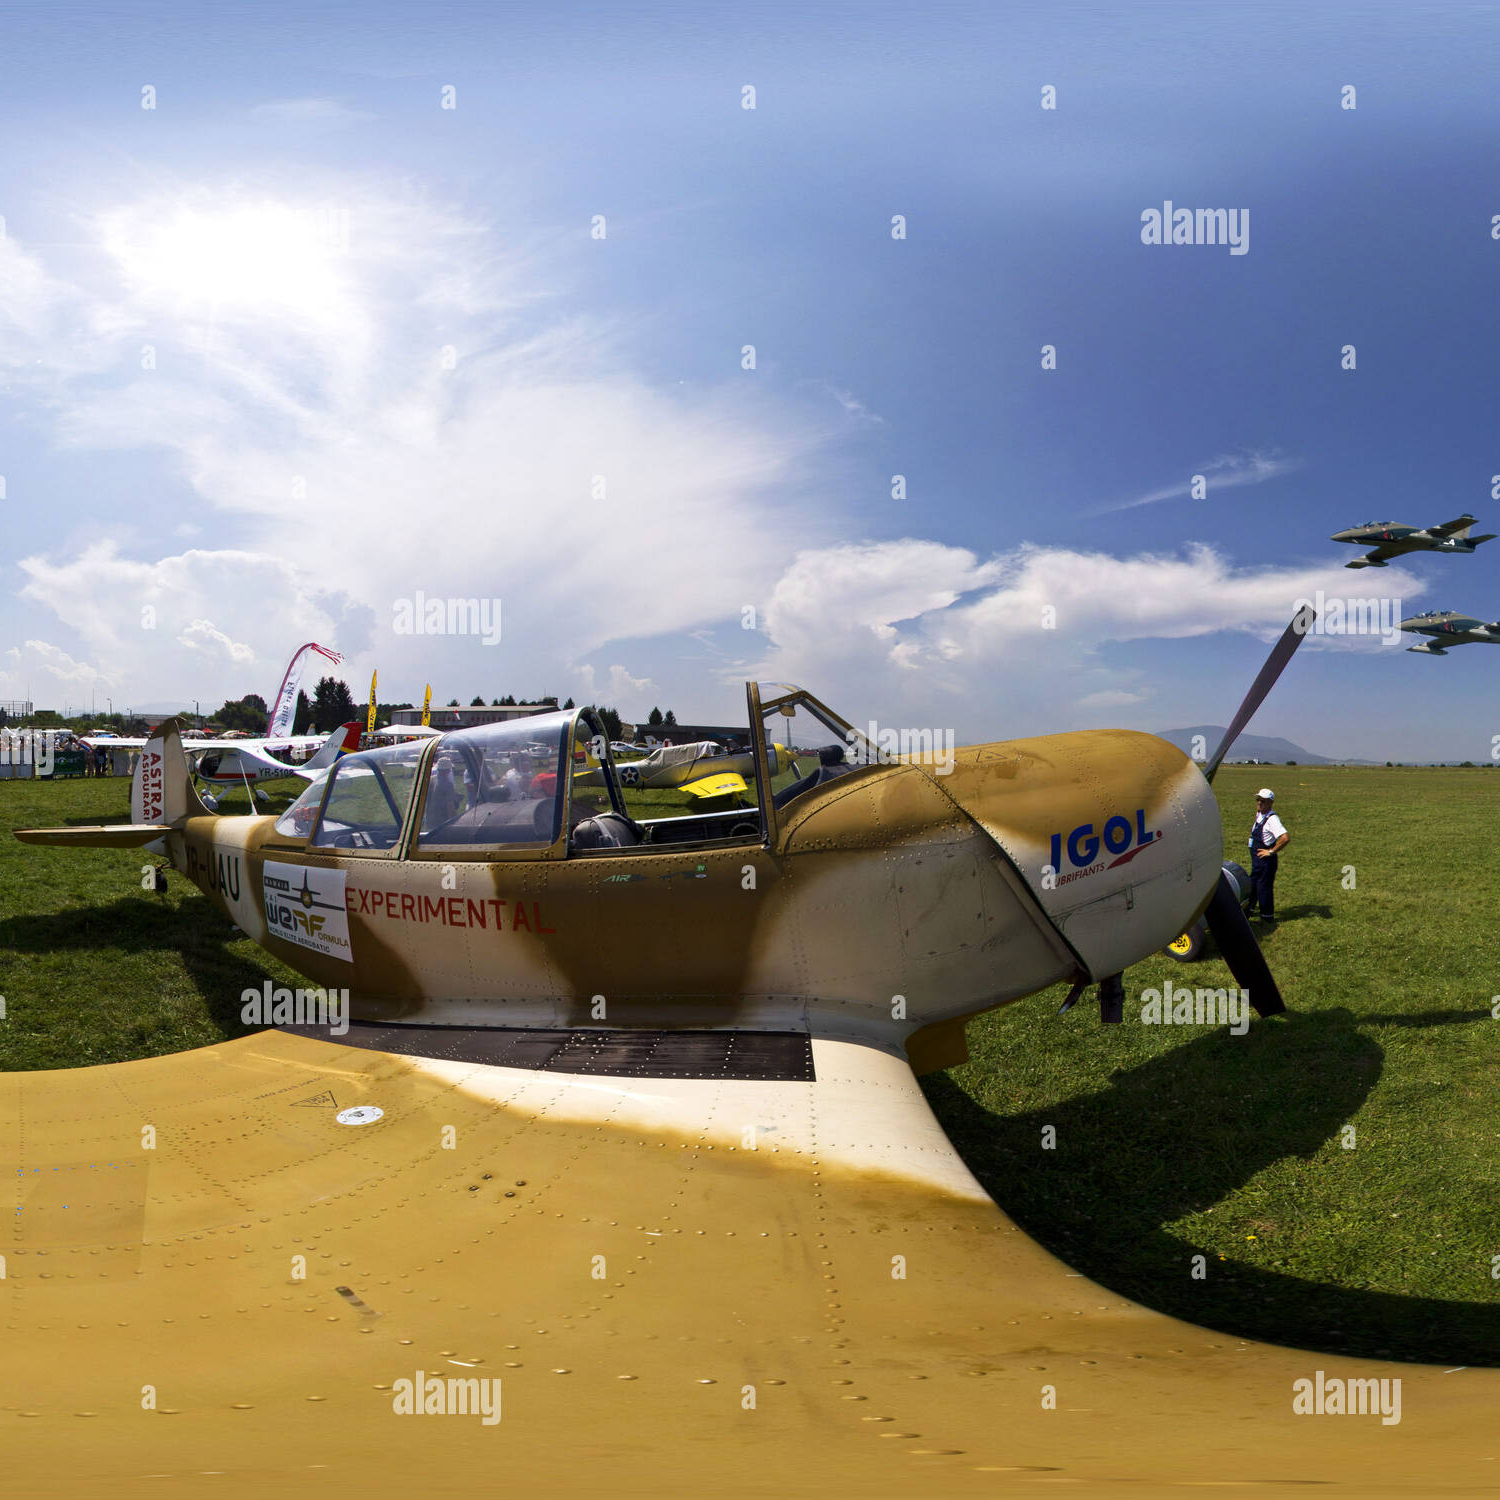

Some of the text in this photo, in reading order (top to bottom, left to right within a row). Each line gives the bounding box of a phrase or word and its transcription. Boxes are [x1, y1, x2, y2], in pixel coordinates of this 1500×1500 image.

[142, 754, 151, 821] ASIGURARI
[151, 752, 163, 820] ASTRA
[258, 767, 294, 777] YR-5108
[344, 887, 557, 934] EXPERIMENTAL
